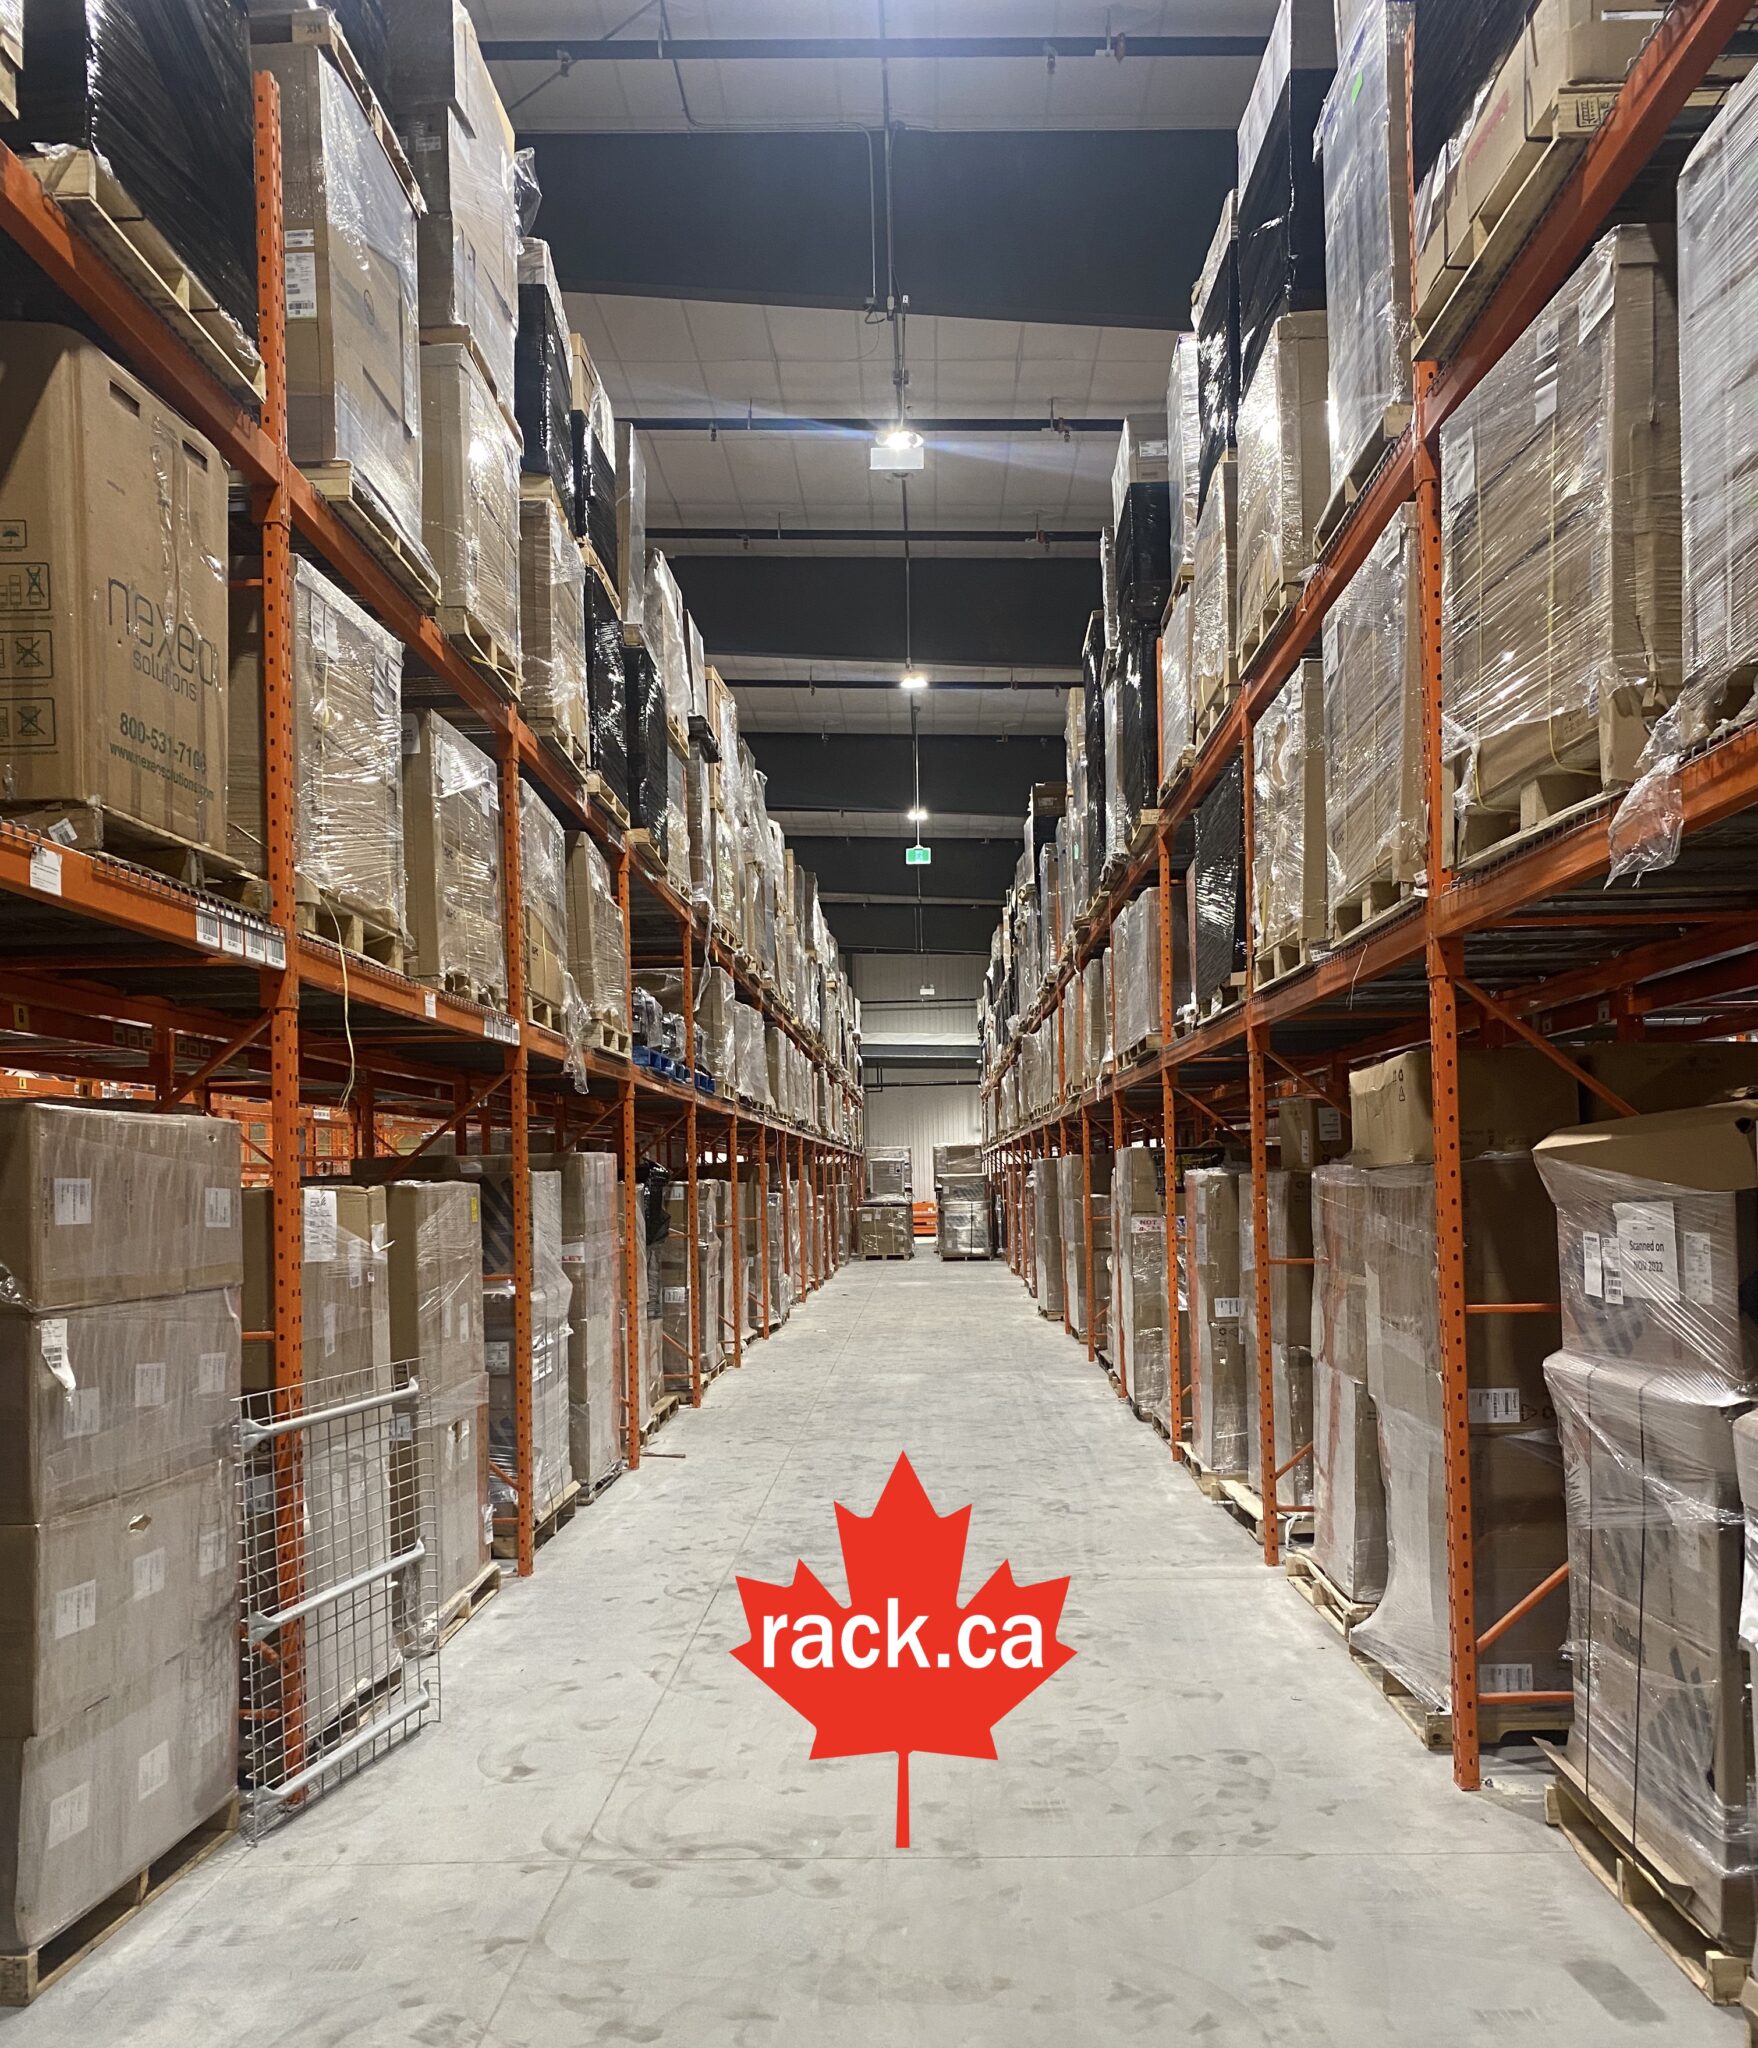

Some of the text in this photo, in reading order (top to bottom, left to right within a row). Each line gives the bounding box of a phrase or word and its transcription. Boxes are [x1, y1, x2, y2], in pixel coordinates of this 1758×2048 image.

[108, 577, 213, 687] nexeo
[133, 649, 197, 702] solutions
[1629, 1240, 1665, 1252] Scanned on
